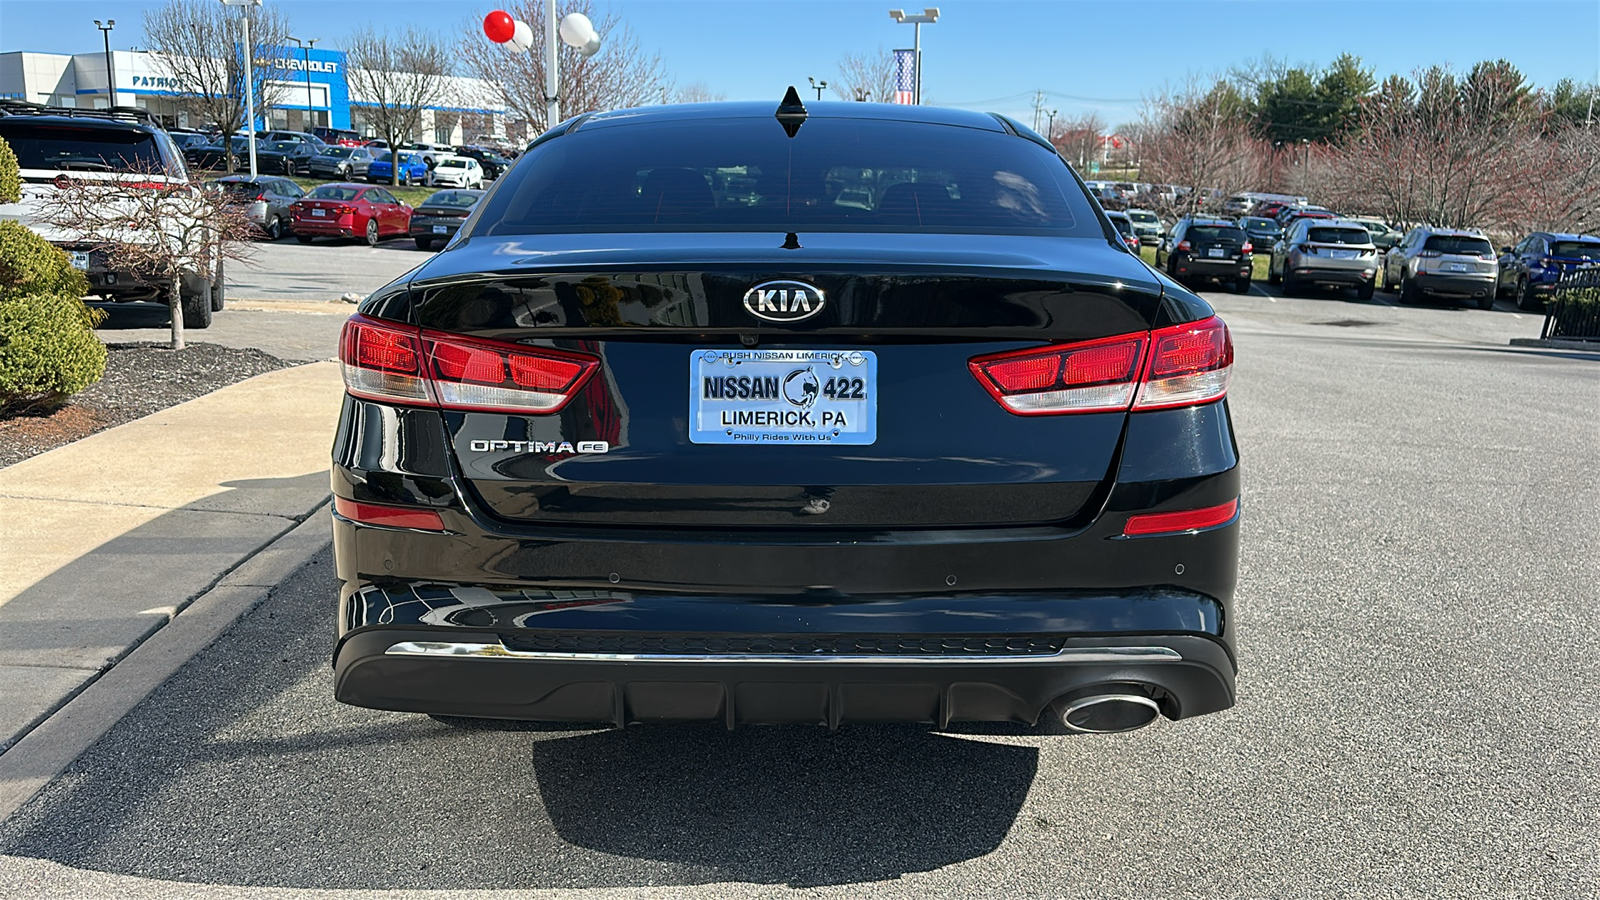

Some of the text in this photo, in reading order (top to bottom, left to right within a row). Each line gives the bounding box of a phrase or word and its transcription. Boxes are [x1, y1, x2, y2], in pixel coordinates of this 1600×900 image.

[757, 289, 812, 313] KIA
[722, 352, 845, 361] BUSH NISSAN LIMERICK
[704, 376, 864, 399] NISSAN 422
[722, 410, 847, 427] LIMERICK, PA
[733, 433, 832, 442] Philly Rides With Us
[470, 440, 576, 453] OPTIMA
